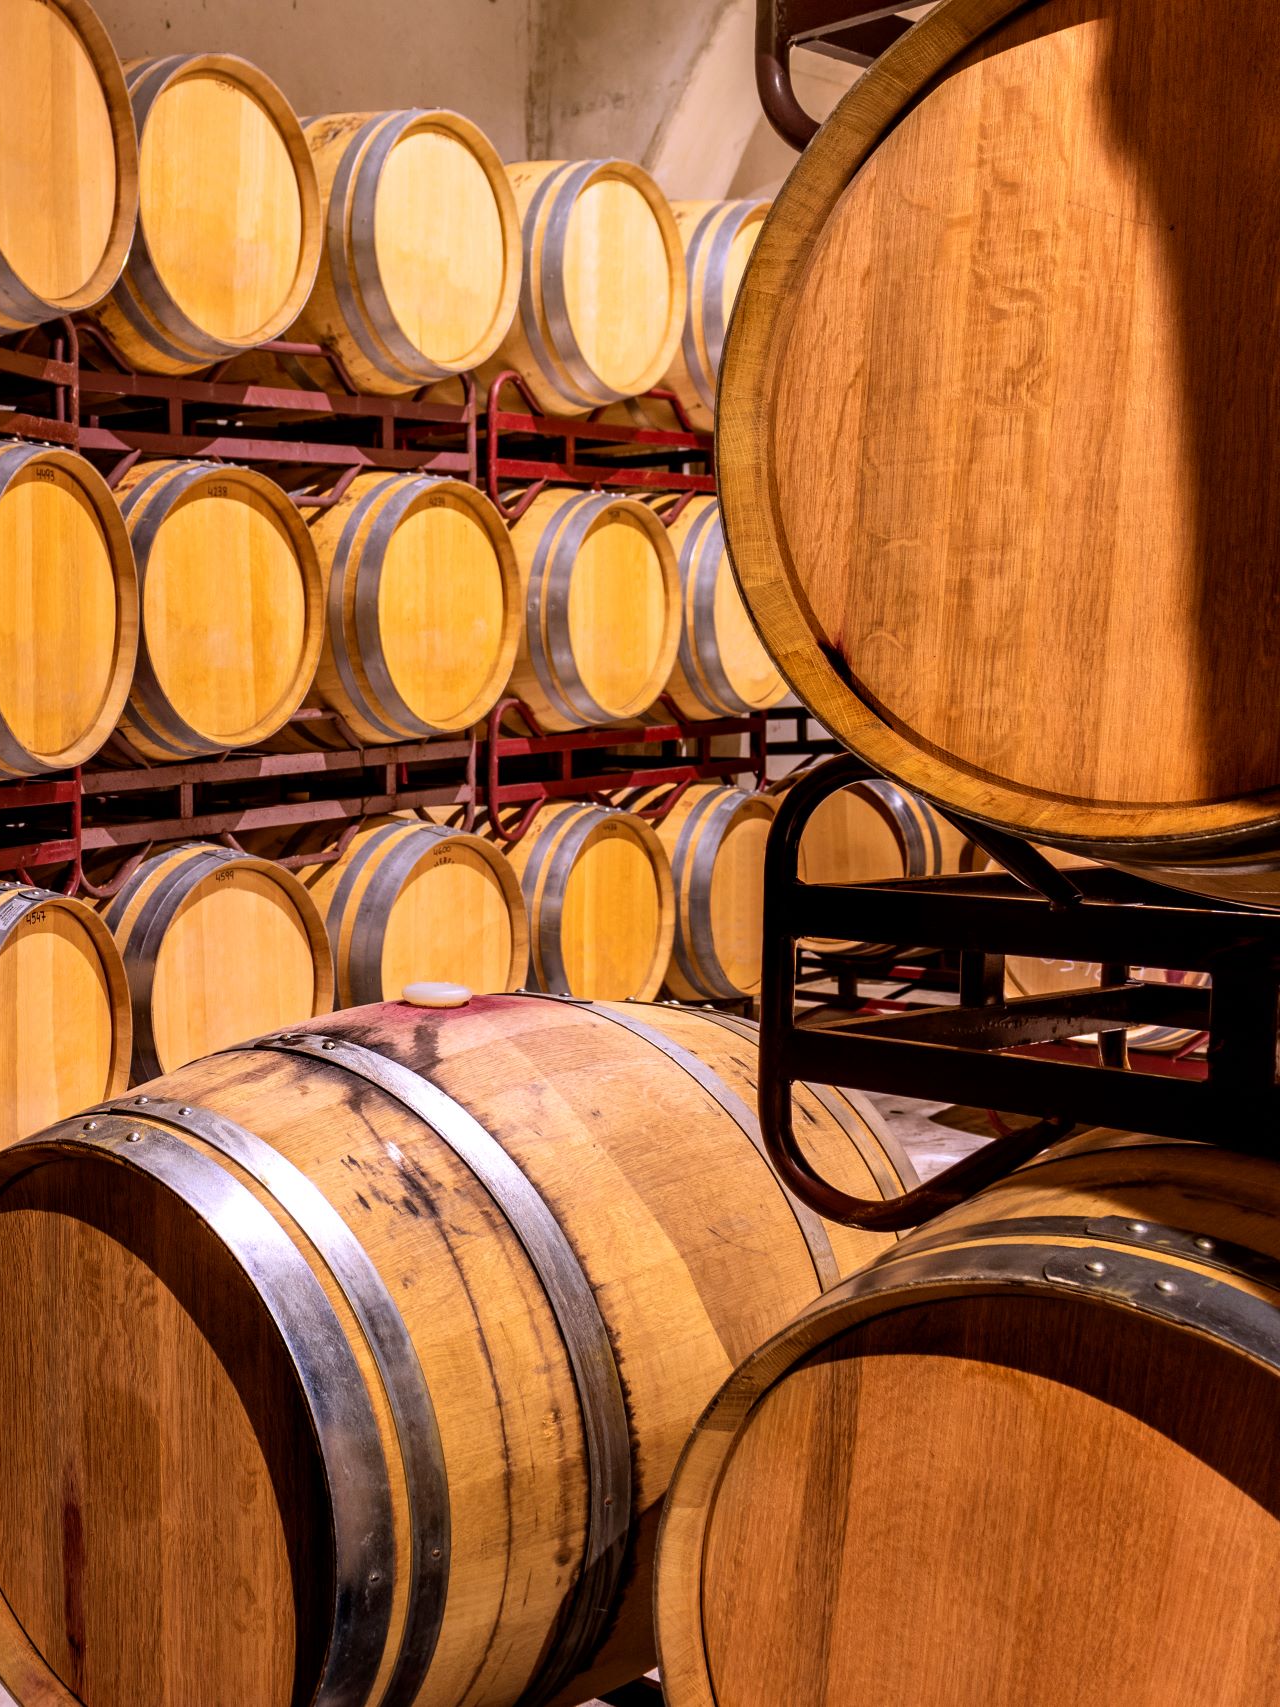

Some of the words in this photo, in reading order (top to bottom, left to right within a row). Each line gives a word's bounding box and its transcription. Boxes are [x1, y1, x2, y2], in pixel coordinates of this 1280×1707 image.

[36, 468, 55, 482] 4493
[215, 870, 235, 883] 4599
[26, 911, 46, 925] 4547
